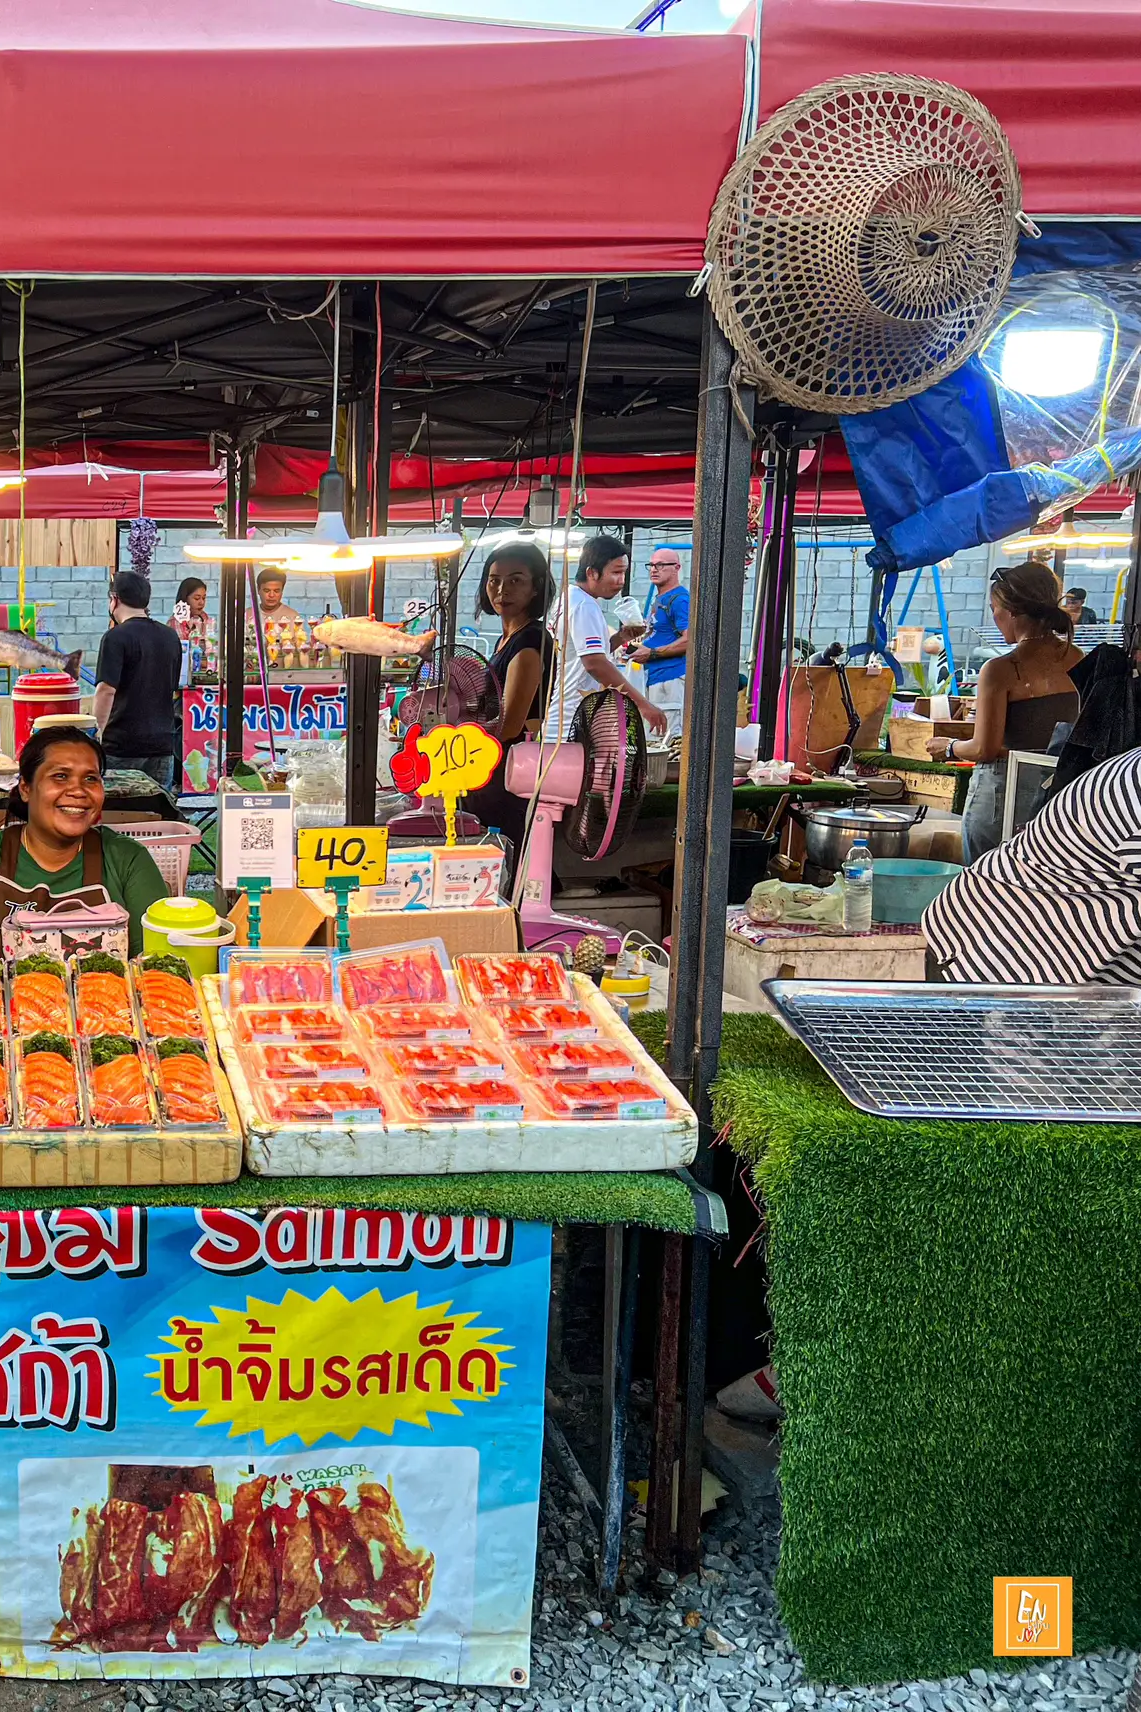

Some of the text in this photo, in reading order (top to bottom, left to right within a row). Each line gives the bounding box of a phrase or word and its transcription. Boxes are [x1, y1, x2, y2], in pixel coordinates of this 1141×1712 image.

[176, 605, 188, 617] 25
[314, 837, 376, 871] 40.-
[162, 1318, 500, 1403] น้ำจิ้มรสเด็ด
